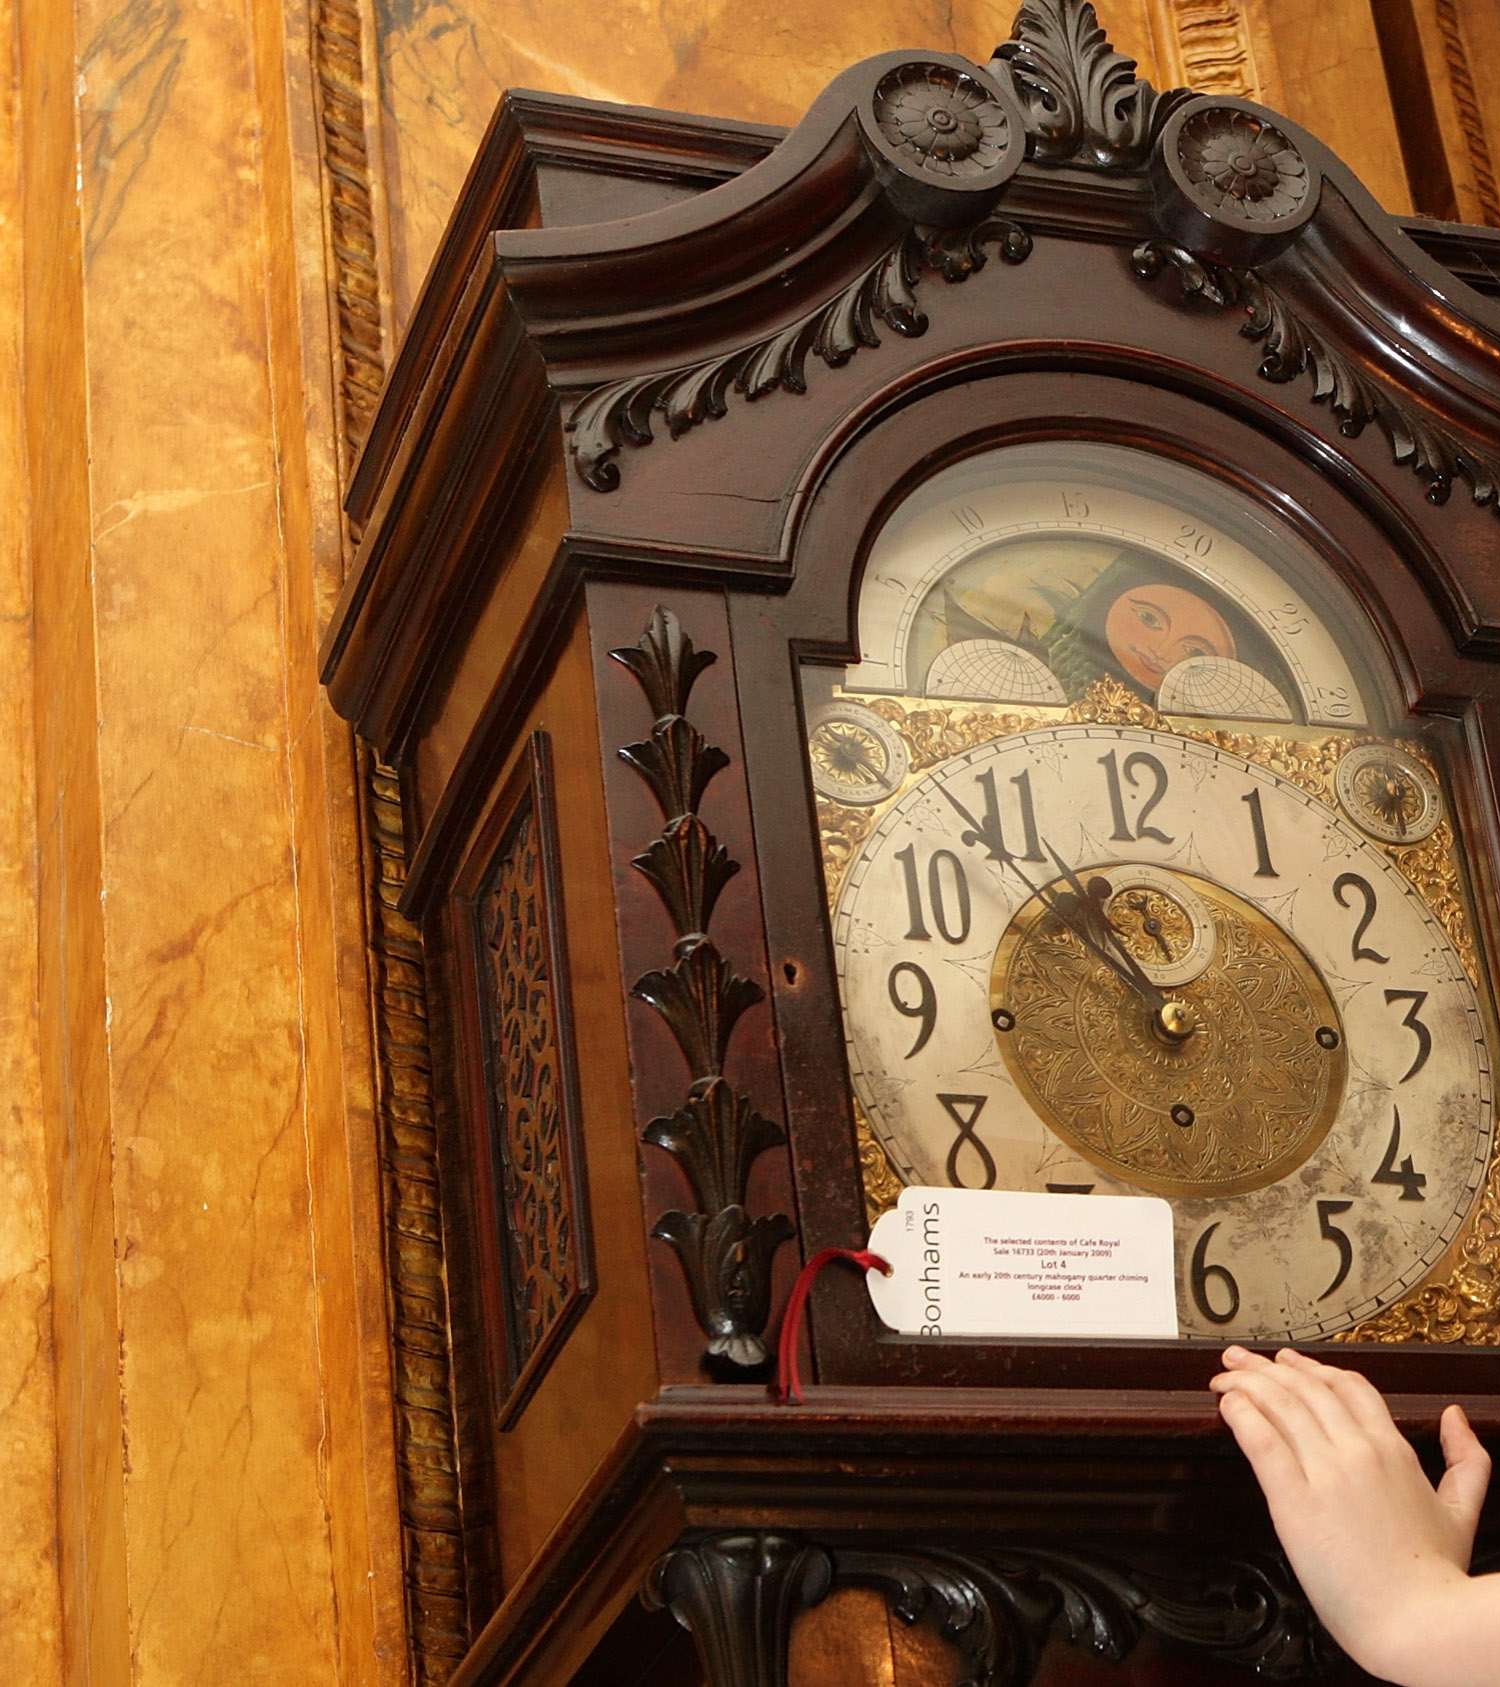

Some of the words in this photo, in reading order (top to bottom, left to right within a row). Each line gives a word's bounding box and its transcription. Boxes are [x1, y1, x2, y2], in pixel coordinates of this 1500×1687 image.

[951, 505, 985, 535] 10
[1173, 524, 1214, 558] 20
[1267, 602, 1311, 635] 25
[975, 766, 1048, 864] 11
[1097, 749, 1175, 845] 12
[1241, 787, 1281, 878] 1
[894, 843, 972, 945] 10
[1332, 871, 1390, 964] 2
[888, 961, 938, 1061] 9
[1384, 988, 1432, 1084] 3
[936, 1093, 997, 1190] 8
[1370, 1103, 1428, 1201] 4
[918, 1203, 942, 1336] Bonhams
[959, 1271, 970, 1279] An
[972, 1271, 992, 1281] early
[994, 1271, 1012, 1280] 20th
[1013, 1273, 1043, 1282] century
[1045, 1273, 1087, 1282] mahogany
[1118, 1274, 1149, 1283] chiming
[983, 1236, 998, 1245] The
[1000, 1237, 1032, 1246] selected
[1069, 1238, 1078, 1246] of
[1099, 1239, 1121, 1248] Royal
[993, 1247, 1010, 1255] Sale
[1036, 1248, 1057, 1257] (20th
[1059, 1249, 1090, 1259] January
[1091, 1249, 1113, 1258] 2009)
[1026, 1282, 1062, 1292] longcase
[1041, 1259, 1058, 1269] Lot
[1060, 1260, 1067, 1269] 4
[1191, 1221, 1240, 1325] 6
[1317, 1200, 1354, 1302] 5
[1062, 1293, 1081, 1301] 6000
